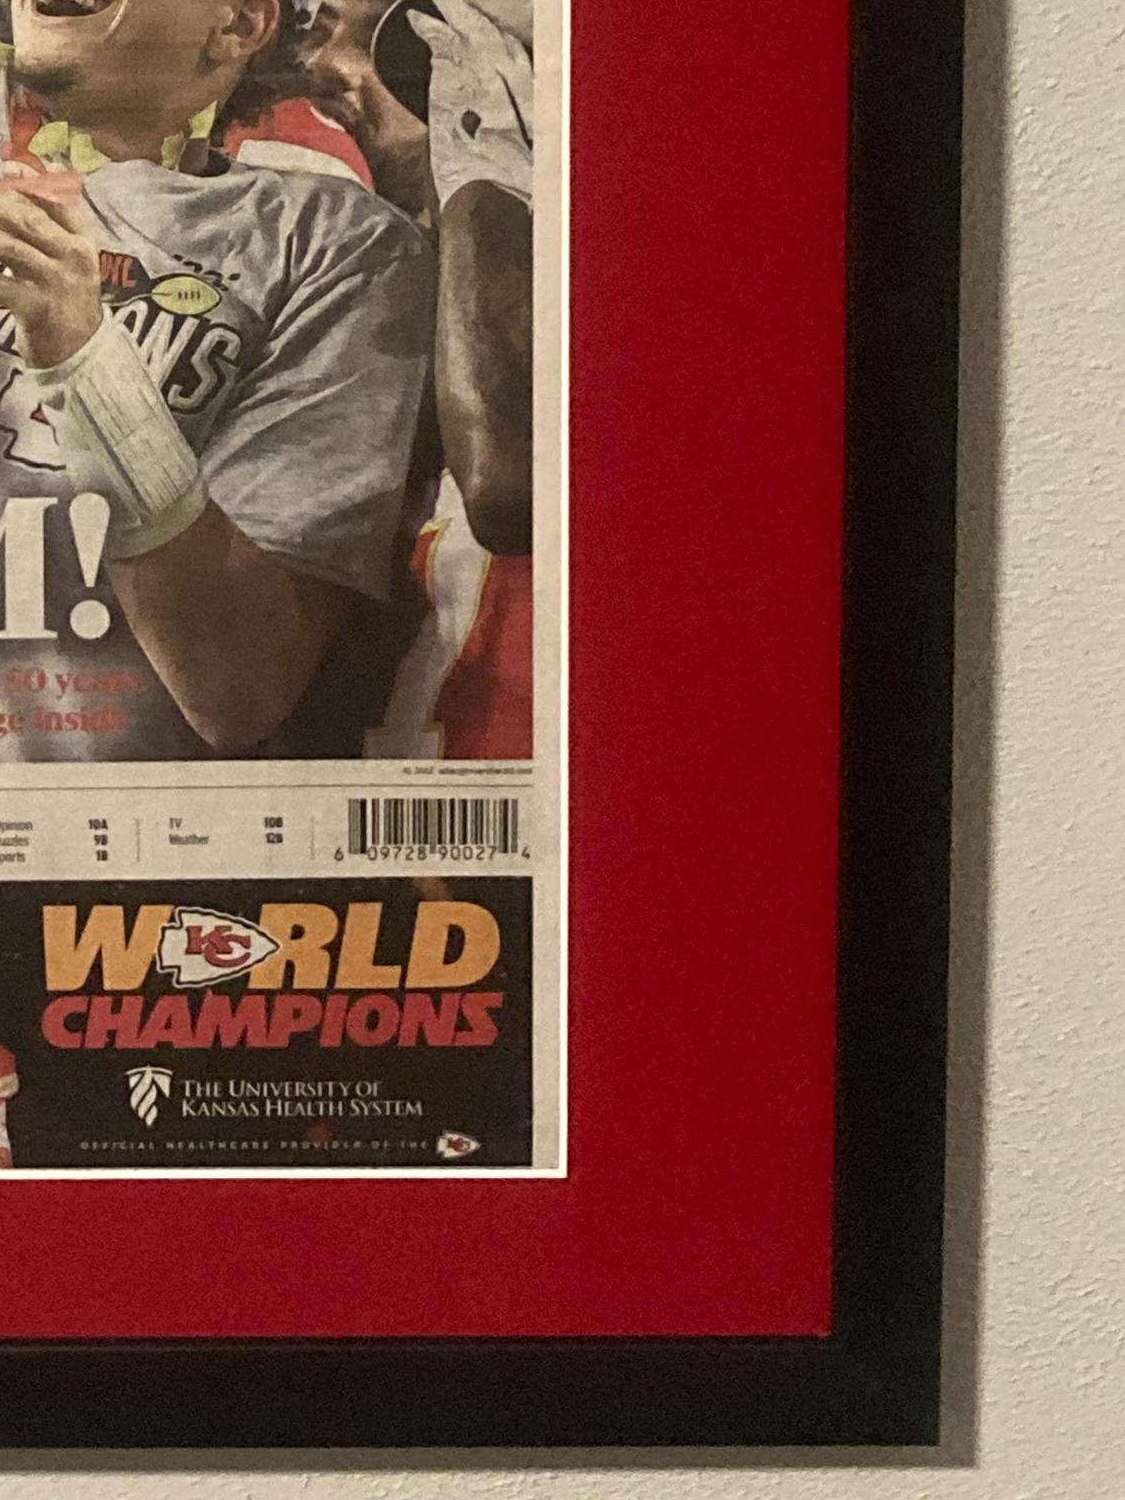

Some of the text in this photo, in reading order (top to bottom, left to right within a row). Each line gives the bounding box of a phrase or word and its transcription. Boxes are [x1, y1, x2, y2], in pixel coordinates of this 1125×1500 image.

[169, 817, 183, 830] TV
[168, 833, 210, 846] Weather
[334, 845, 531, 862] 6 09728 90027 4
[41, 901, 502, 991] WRLD
[41, 990, 504, 1050] CHAMPIONS
[183, 1079, 382, 1098] THE UNIVERSITY OF
[181, 1098, 424, 1118] KANSAS HEALTH SYSTEM
[80, 1141, 155, 1151] OFFICIAL
[166, 1141, 270, 1150] HEALTHCARE
[280, 1140, 361, 1150] PROVIDER
